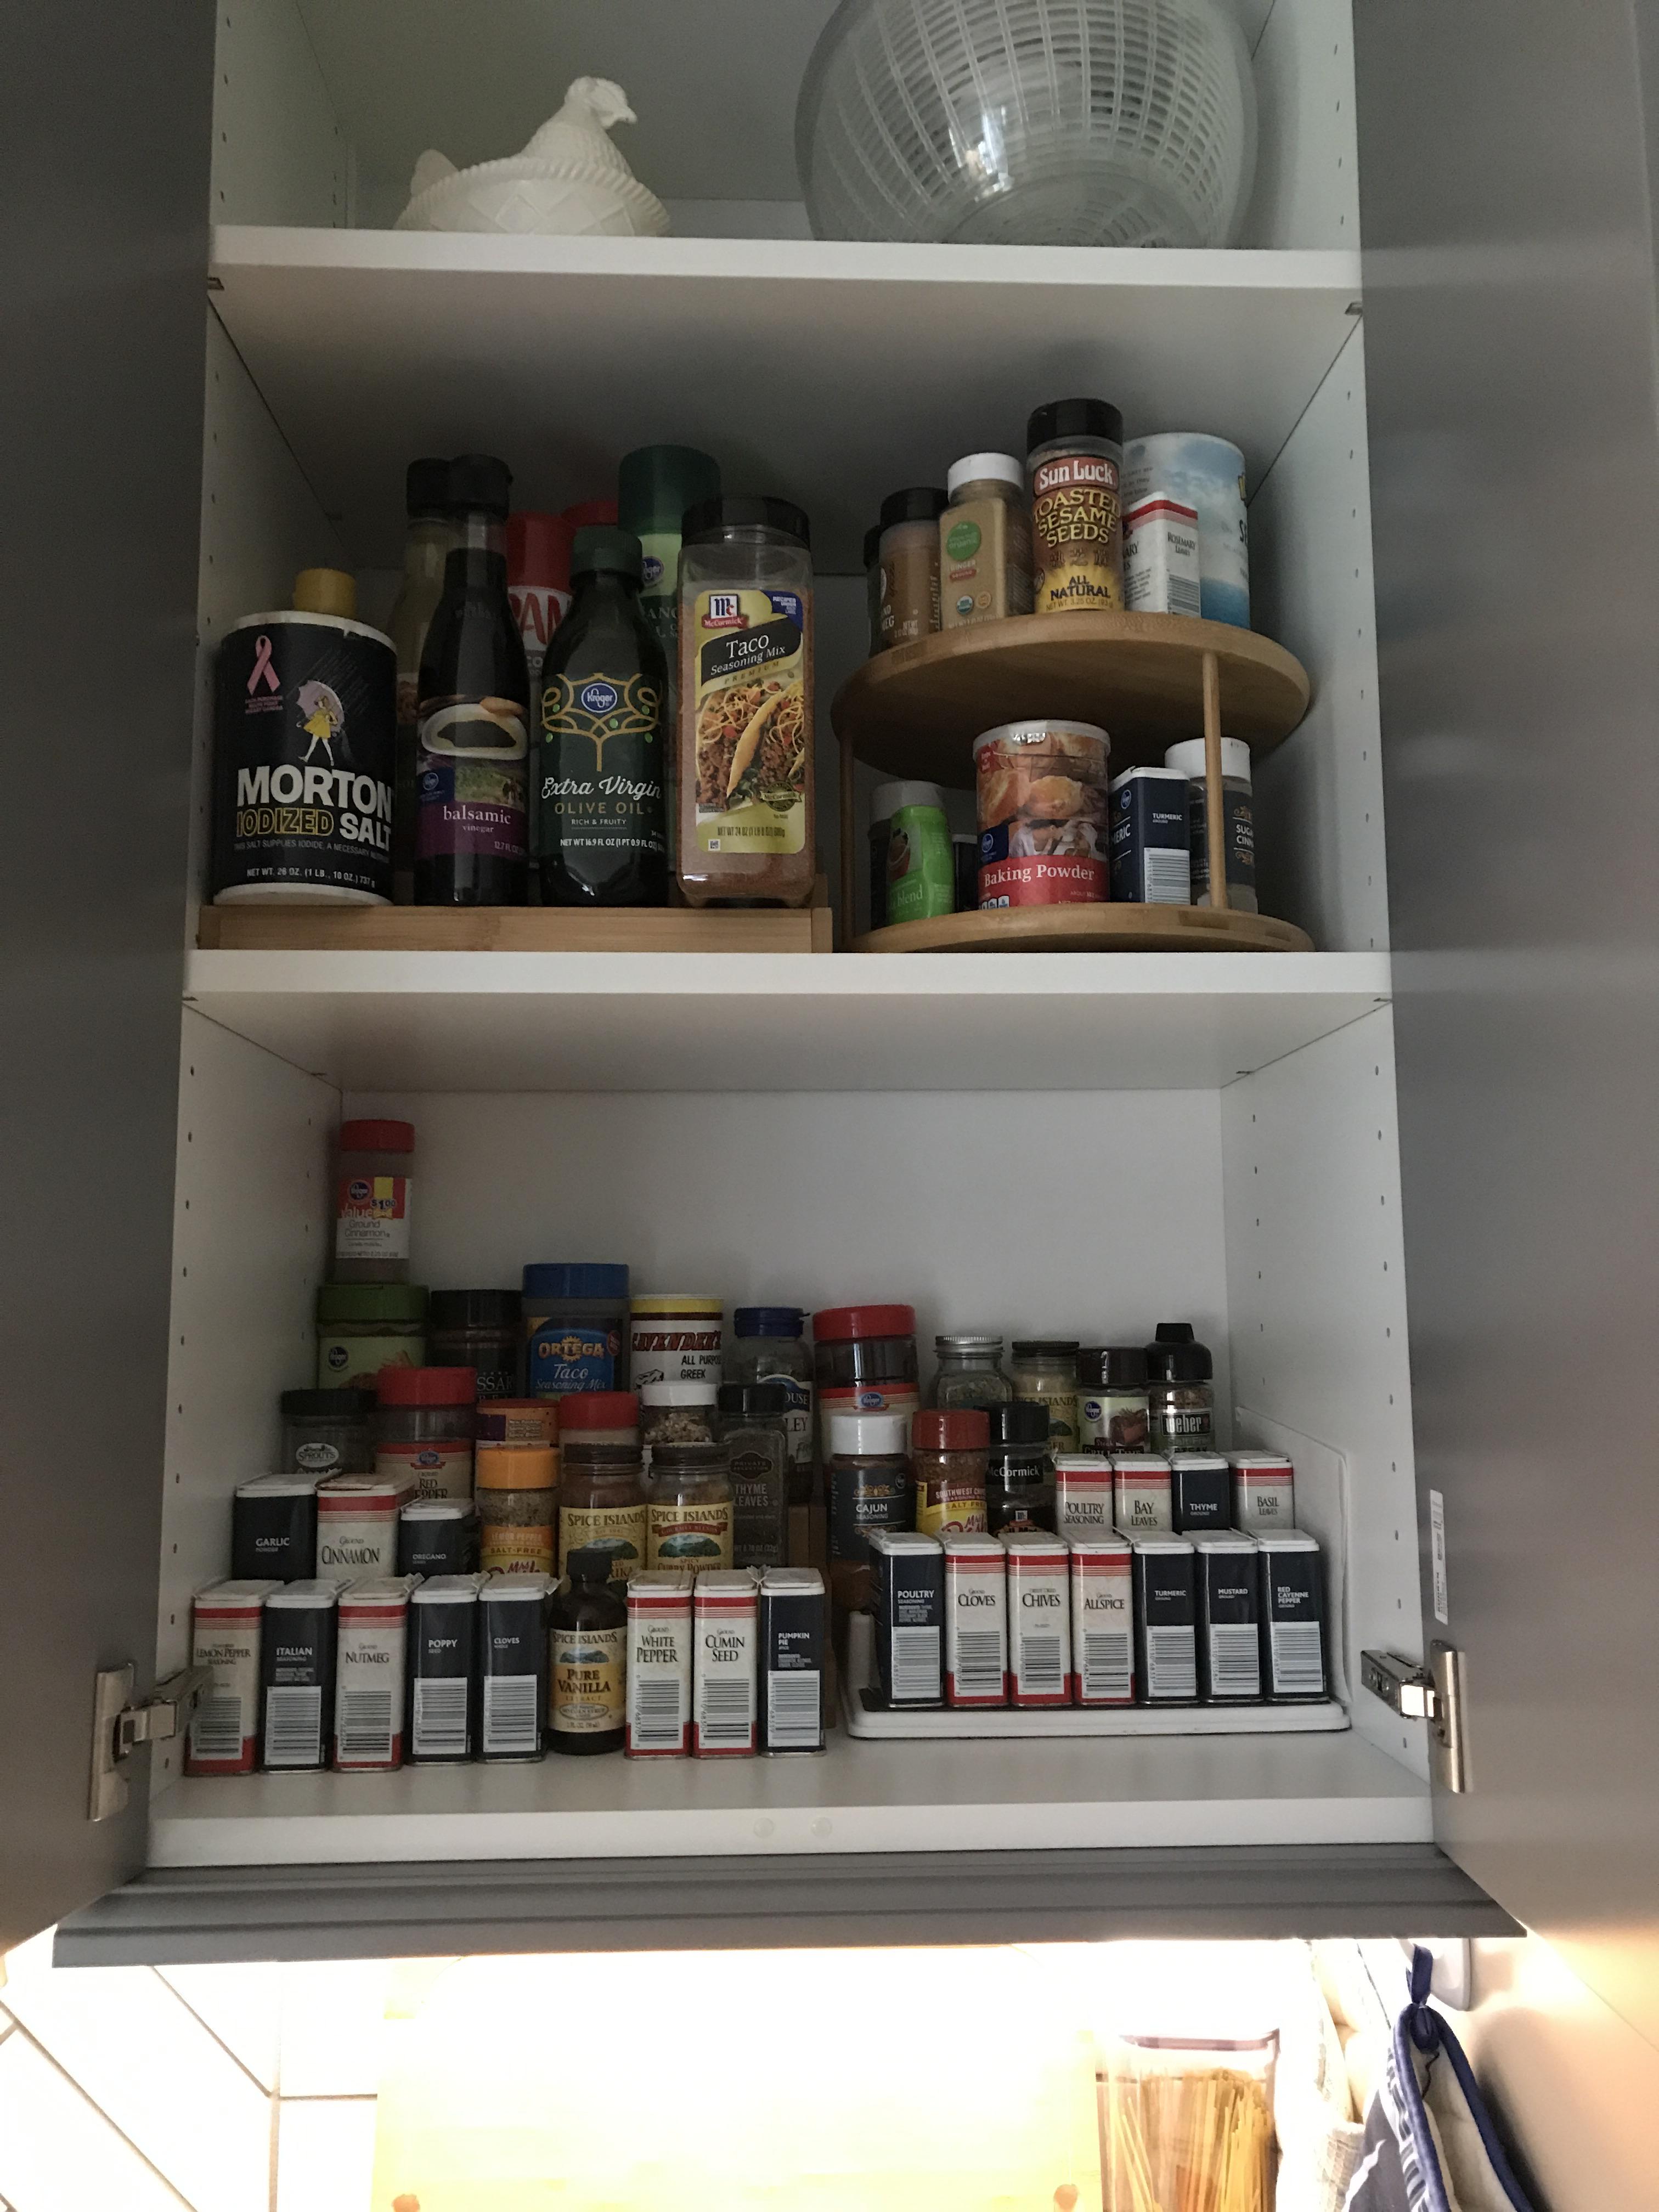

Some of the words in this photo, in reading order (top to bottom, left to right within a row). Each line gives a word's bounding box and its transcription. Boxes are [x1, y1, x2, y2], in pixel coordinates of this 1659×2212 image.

[1039, 465, 1070, 490] Sun
[1074, 460, 1113, 484] Luck
[1038, 506, 1117, 537] SESAME
[1048, 523, 1109, 549] SEEDS
[1069, 575, 1089, 585] ALL
[1050, 585, 1111, 601] NATURAL
[704, 618, 742, 627] McCormick
[726, 634, 769, 659] Taco
[710, 651, 764, 676] Seasoning
[766, 645, 786, 659] Mix
[586, 687, 613, 709] Kroger
[236, 764, 392, 824] MORTON
[541, 776, 594, 800] Extra
[599, 776, 662, 800] Virgin
[443, 804, 512, 825] balsamic
[554, 802, 607, 815] OLIVE
[615, 802, 645, 815] OIL
[1152, 812, 1183, 821] TURMERIC
[236, 808, 335, 838] IODIZED
[339, 812, 392, 852] SALT
[462, 824, 494, 833] vinegar
[246, 840, 263, 850] SALT
[560, 838, 573, 847] NET
[573, 838, 584, 847] WT
[597, 838, 605, 846] FL
[605, 838, 615, 846] OZ
[984, 867, 1032, 887] Baking
[1036, 864, 1095, 881] Powder
[349, 1220, 380, 1228] Ground
[345, 1229, 387, 1238] Cinnamon
[538, 1342, 606, 1360] ORTEGA
[681, 1355, 695, 1365] ALL
[554, 1363, 589, 1379] Taco
[680, 1369, 706, 1379] GREEK
[535, 1378, 585, 1392] Seasoning
[298, 1450, 336, 1461] SPROUTS
[419, 1478, 438, 1489] RED
[735, 1483, 767, 1494] THYME
[735, 1496, 769, 1506] LEAVES
[1135, 1500, 1154, 1514] BAY
[1189, 1503, 1218, 1511] THYME
[1257, 1496, 1280, 1508] BASIL
[684, 1507, 729, 1522] ISLANDS
[855, 1503, 888, 1515] CAJUN
[1065, 1502, 1105, 1515] POULTRY
[567, 1513, 601, 1527] SPICE
[603, 1510, 647, 1526] ISLANDS
[1064, 1515, 1105, 1525] SEASONING
[1131, 1515, 1158, 1526] LEAVES
[255, 1537, 290, 1547] GARLIC
[321, 1545, 380, 1565] CINNAMON
[897, 1589, 935, 1599] POULTRY
[958, 1593, 996, 1607] CLOVES
[1022, 1593, 1061, 1607] CHIVES
[1084, 1598, 1125, 1610] ALLSPICE
[493, 1637, 521, 1645] CLOVES
[578, 1630, 618, 1644] ISLANDS
[641, 1635, 675, 1647] WHITE
[705, 1634, 745, 1649] CUMIN
[427, 1639, 459, 1649] POPPY
[276, 1646, 313, 1656] ITALIAN
[345, 1651, 390, 1664] NUTMEG
[636, 1647, 679, 1663] PEPPER
[712, 1649, 738, 1662] SEED
[566, 1668, 601, 1680] PURE
[557, 1679, 612, 1694] VANILLA
